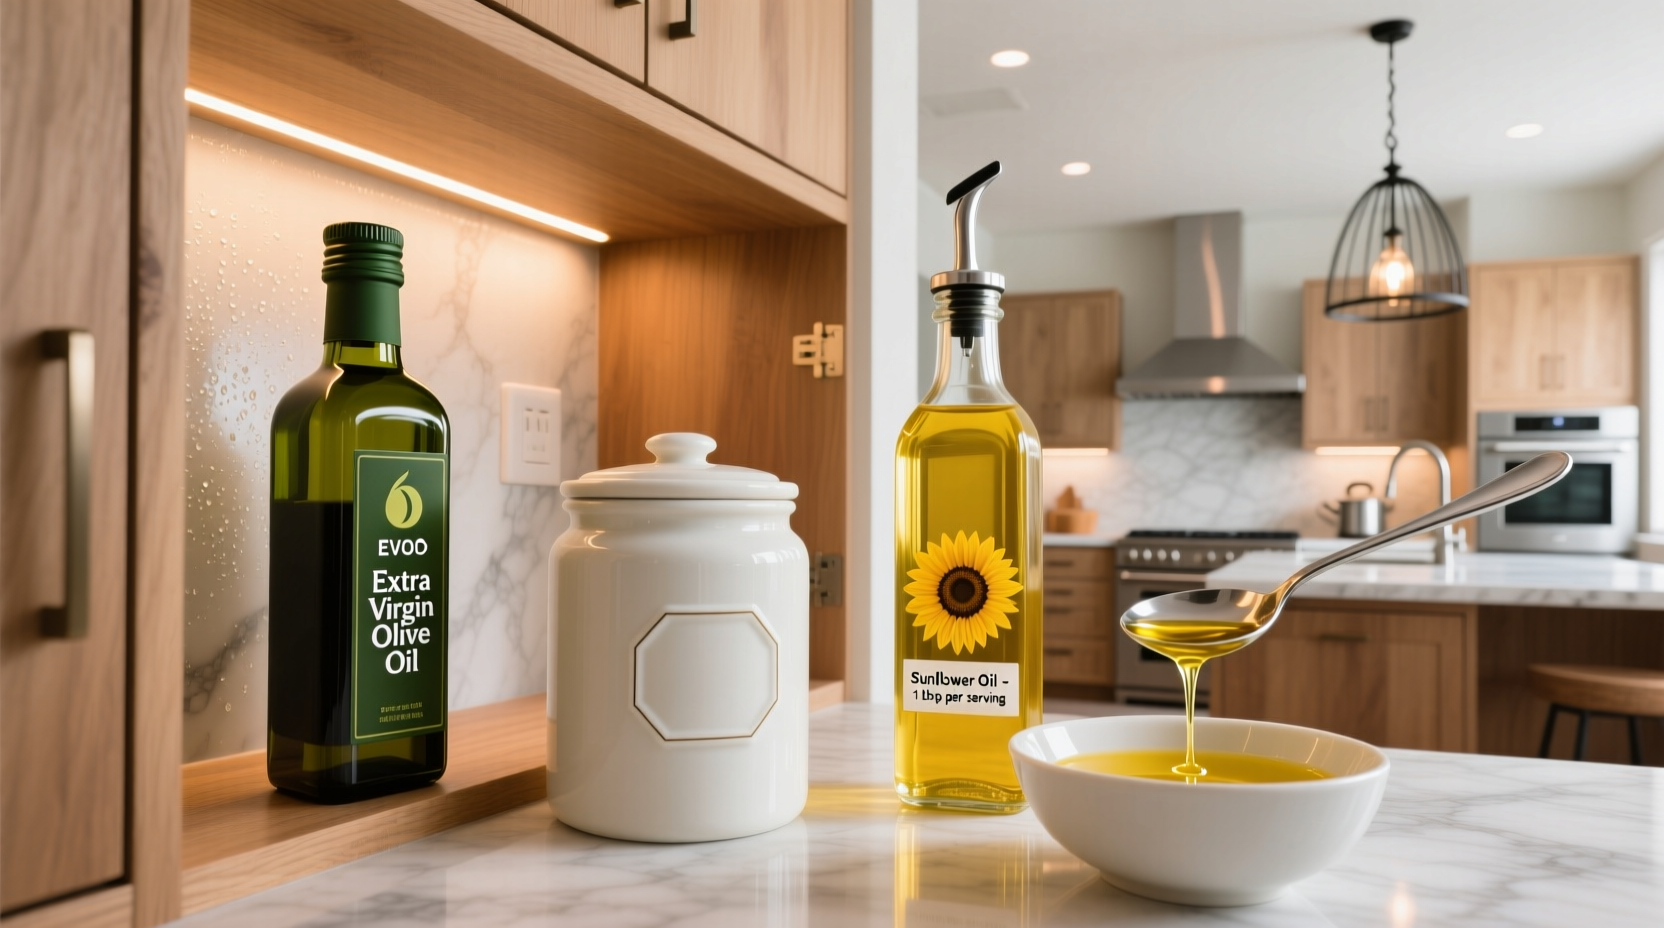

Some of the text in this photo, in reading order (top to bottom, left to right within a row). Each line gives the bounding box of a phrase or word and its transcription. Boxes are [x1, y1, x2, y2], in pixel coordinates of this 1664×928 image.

[372, 569, 431, 593] Extra
[368, 595, 434, 628] Virgin
[371, 620, 431, 649] Olive
[385, 648, 419, 675] Oil
[978, 673, 997, 687] Oil
[913, 689, 918, 700] 1
[945, 693, 963, 705] per
[967, 692, 1006, 707] serving
